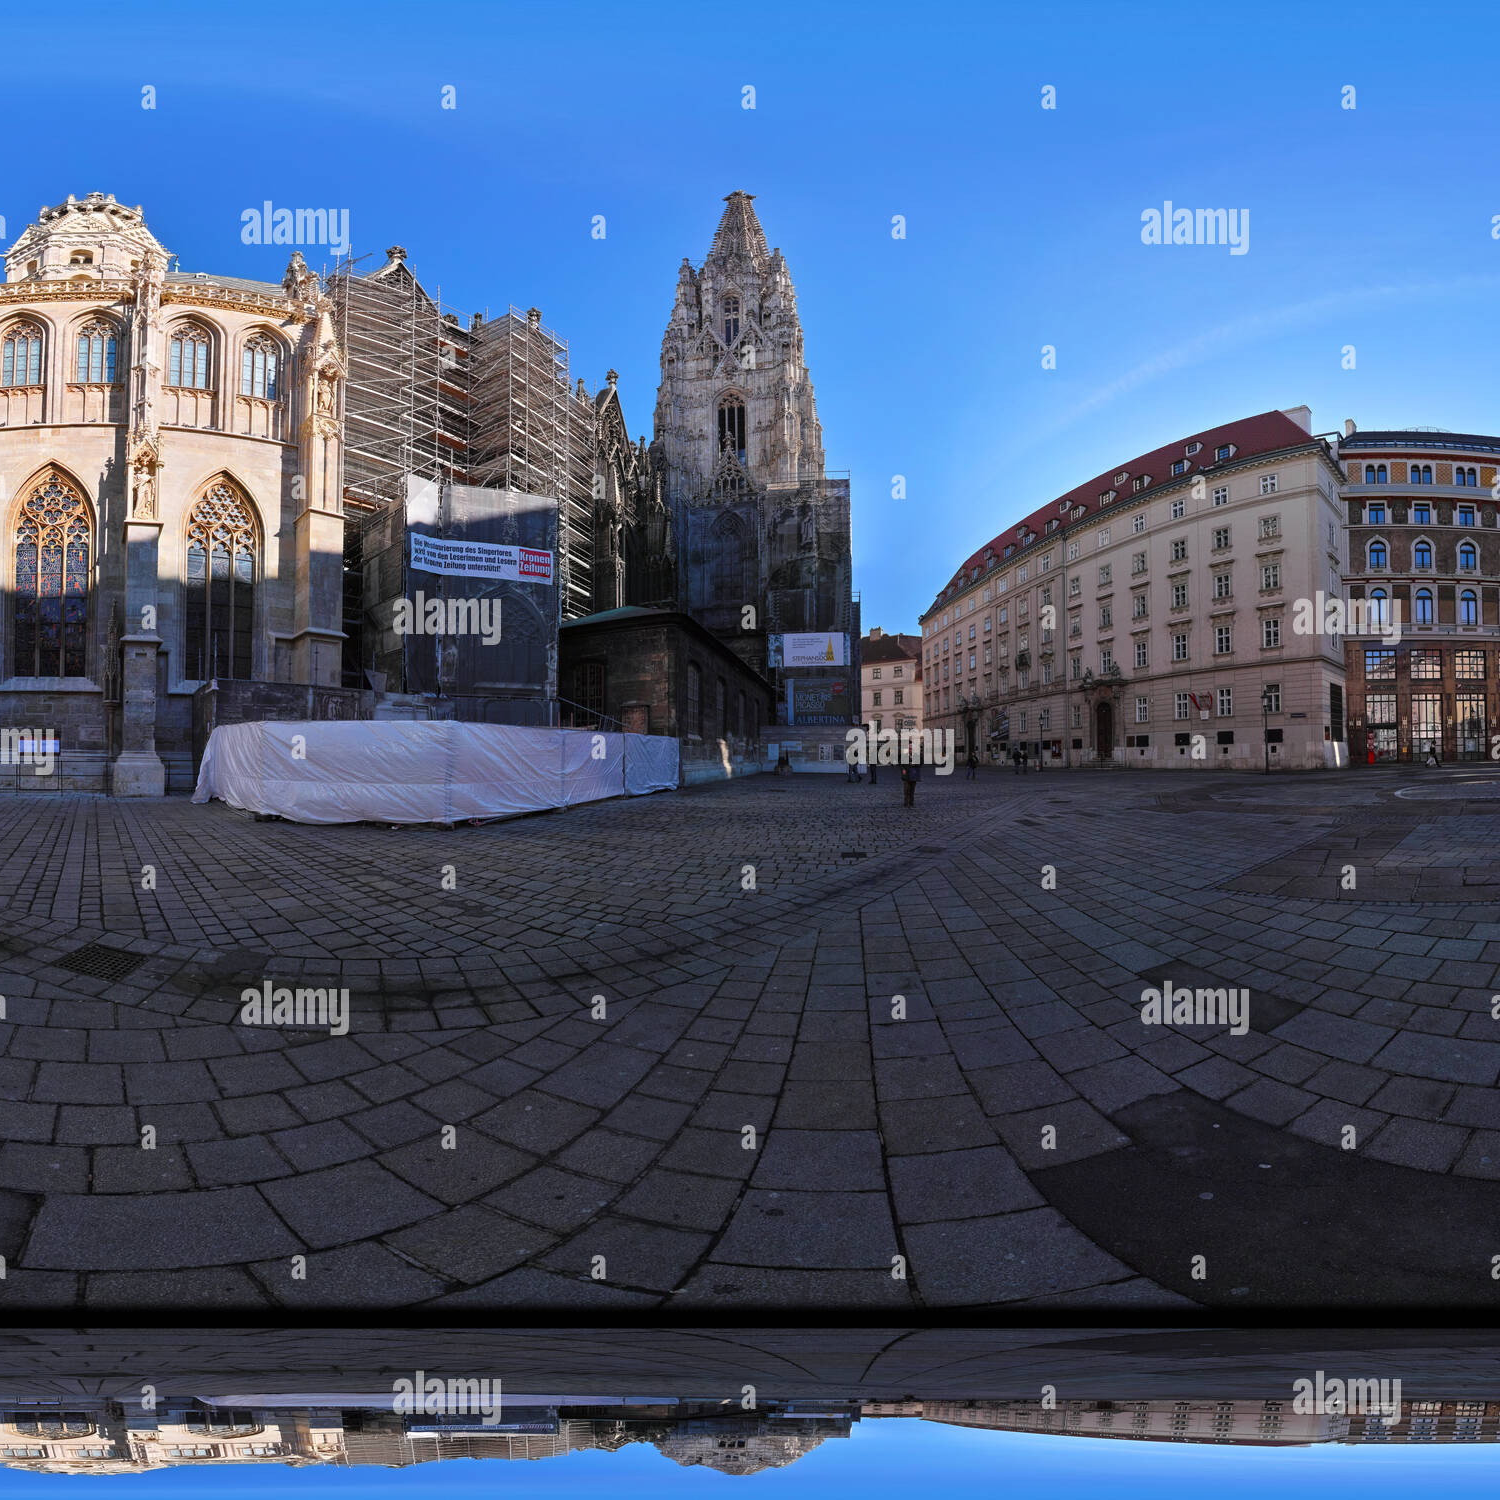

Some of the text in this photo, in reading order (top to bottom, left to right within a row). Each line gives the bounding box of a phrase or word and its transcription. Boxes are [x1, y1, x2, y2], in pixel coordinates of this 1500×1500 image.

[465, 546, 476, 554] des
[520, 551, 550, 564] Kronen
[444, 561, 466, 570] Zeitung
[520, 560, 550, 575] Zeitung
